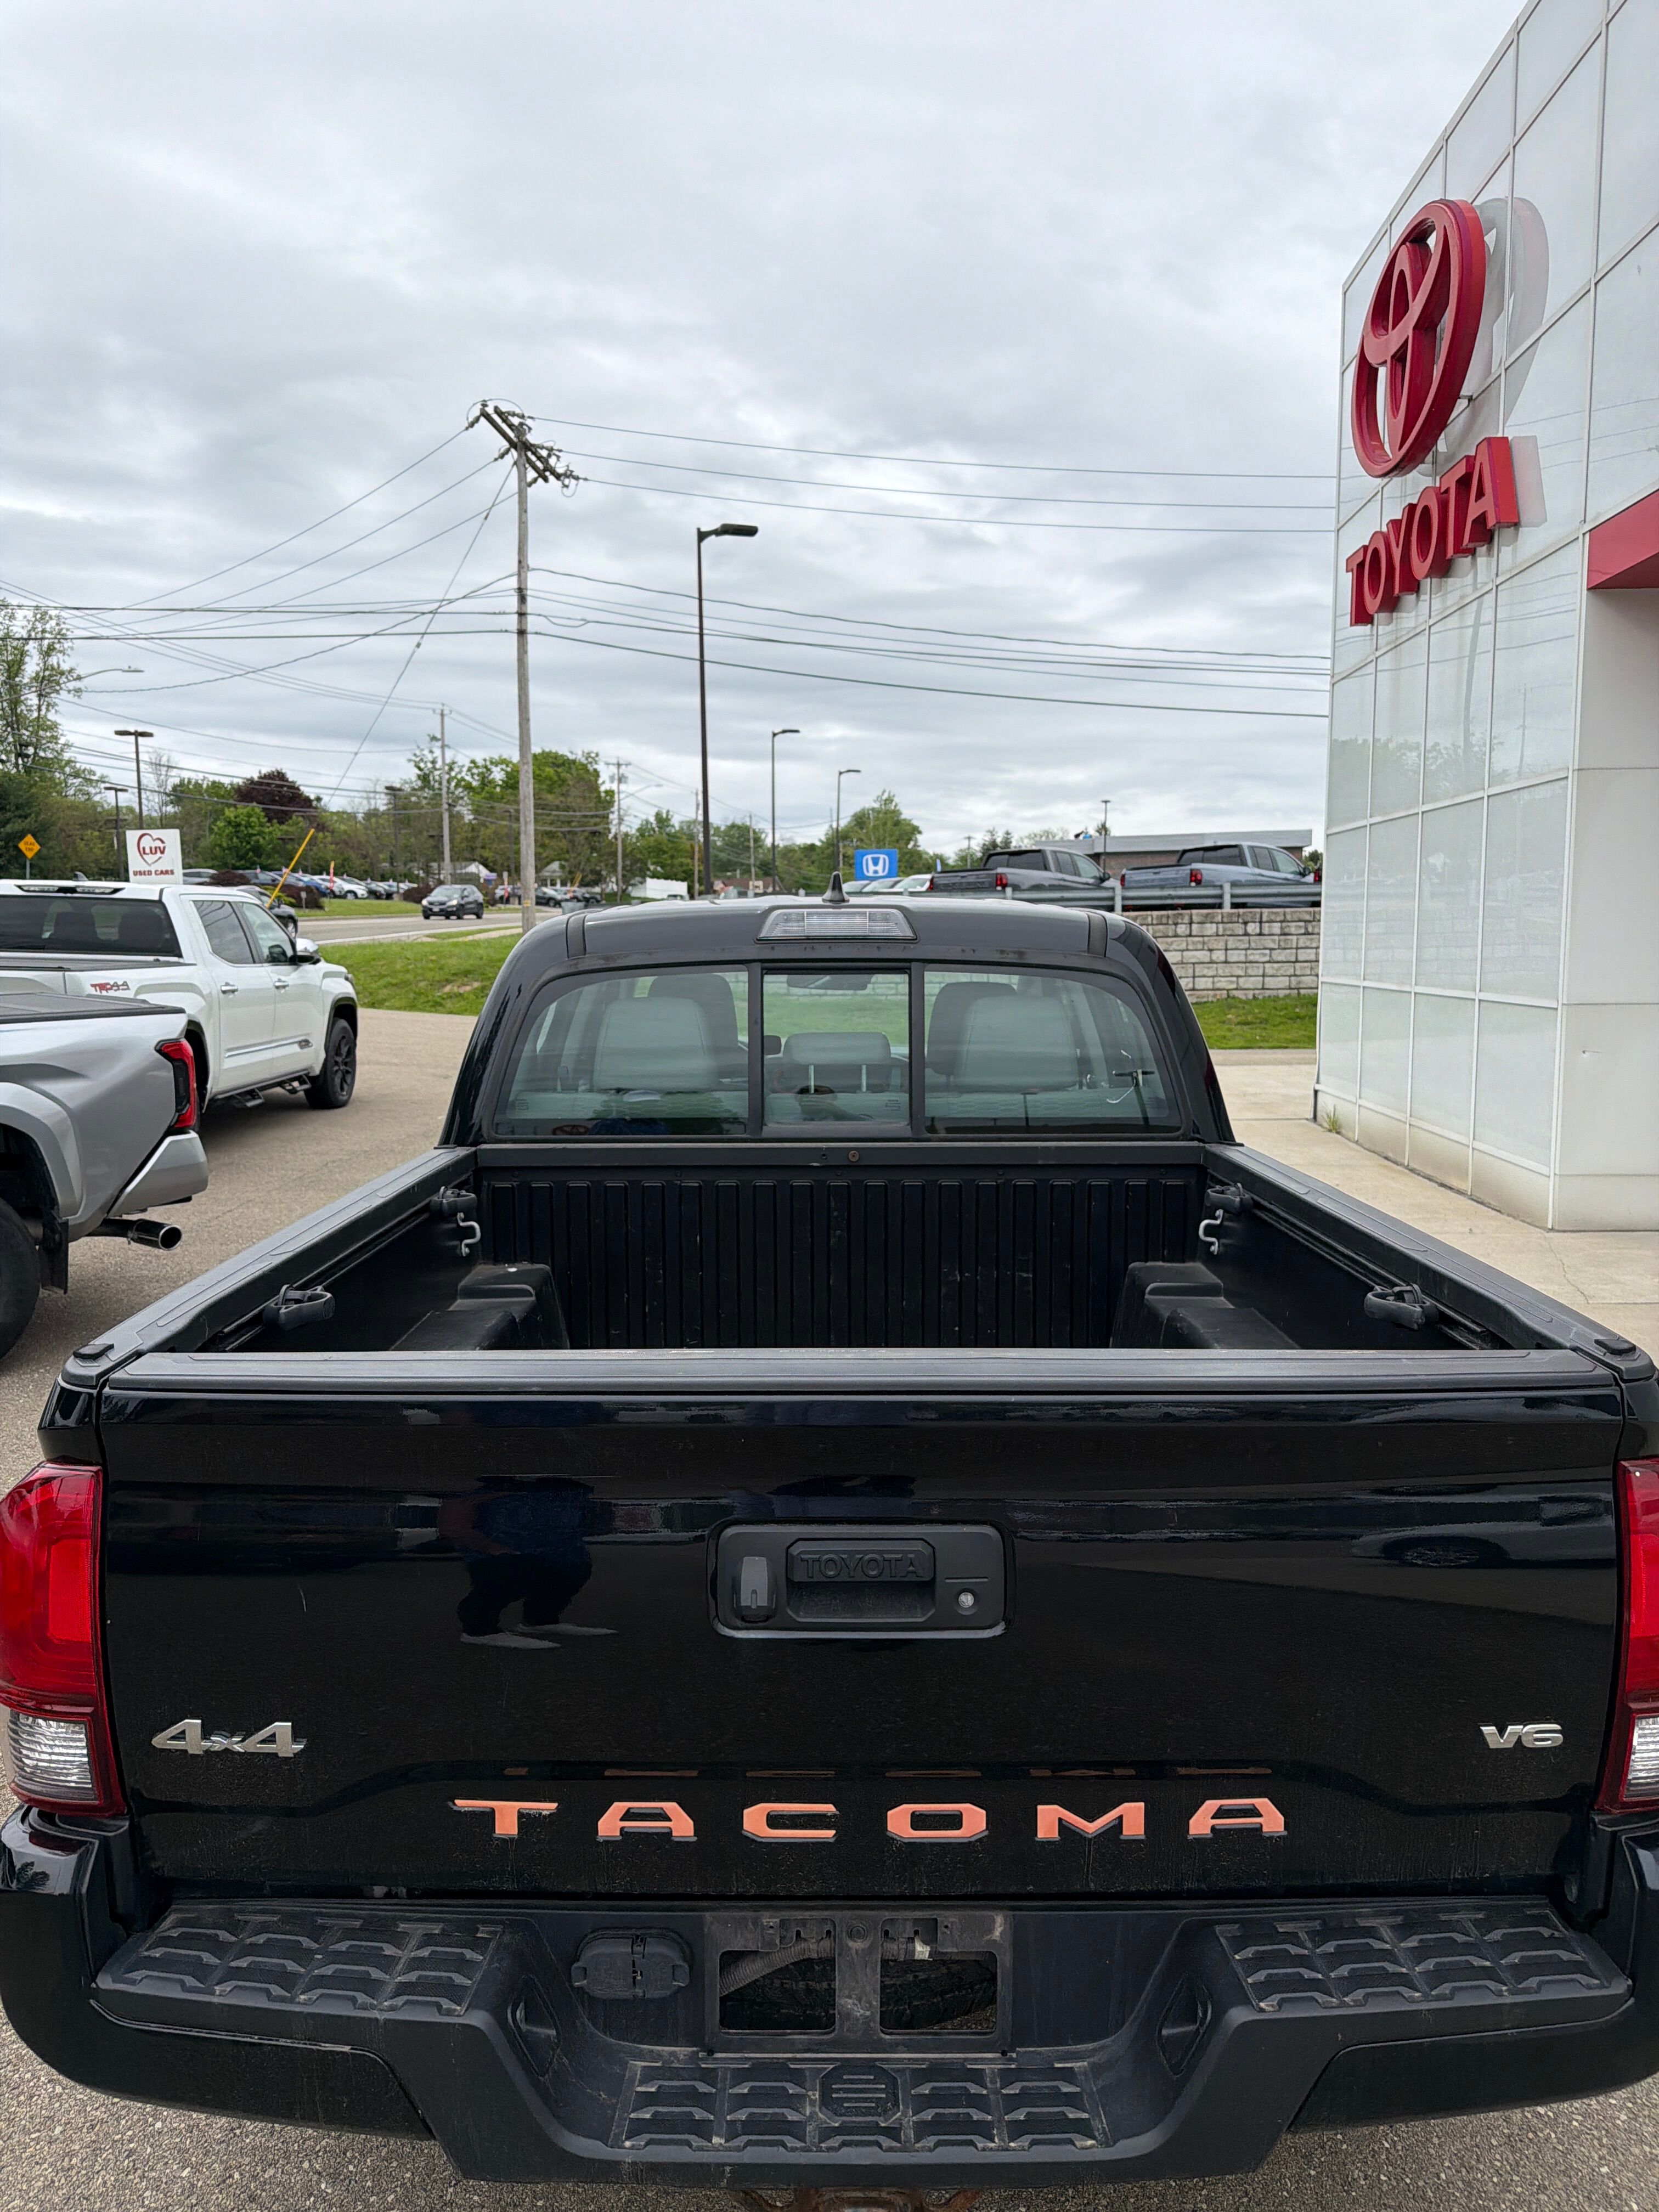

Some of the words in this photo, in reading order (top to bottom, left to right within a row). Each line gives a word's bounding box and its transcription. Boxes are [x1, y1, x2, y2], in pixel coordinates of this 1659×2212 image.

[1346, 436, 1519, 627] TOYOTA
[143, 846, 166, 855] LUV
[800, 1554, 923, 1578] TOYOTA
[151, 1719, 307, 1757] 4x4
[1479, 1723, 1564, 1749] V6
[450, 1797, 1287, 1842] TACOMA
